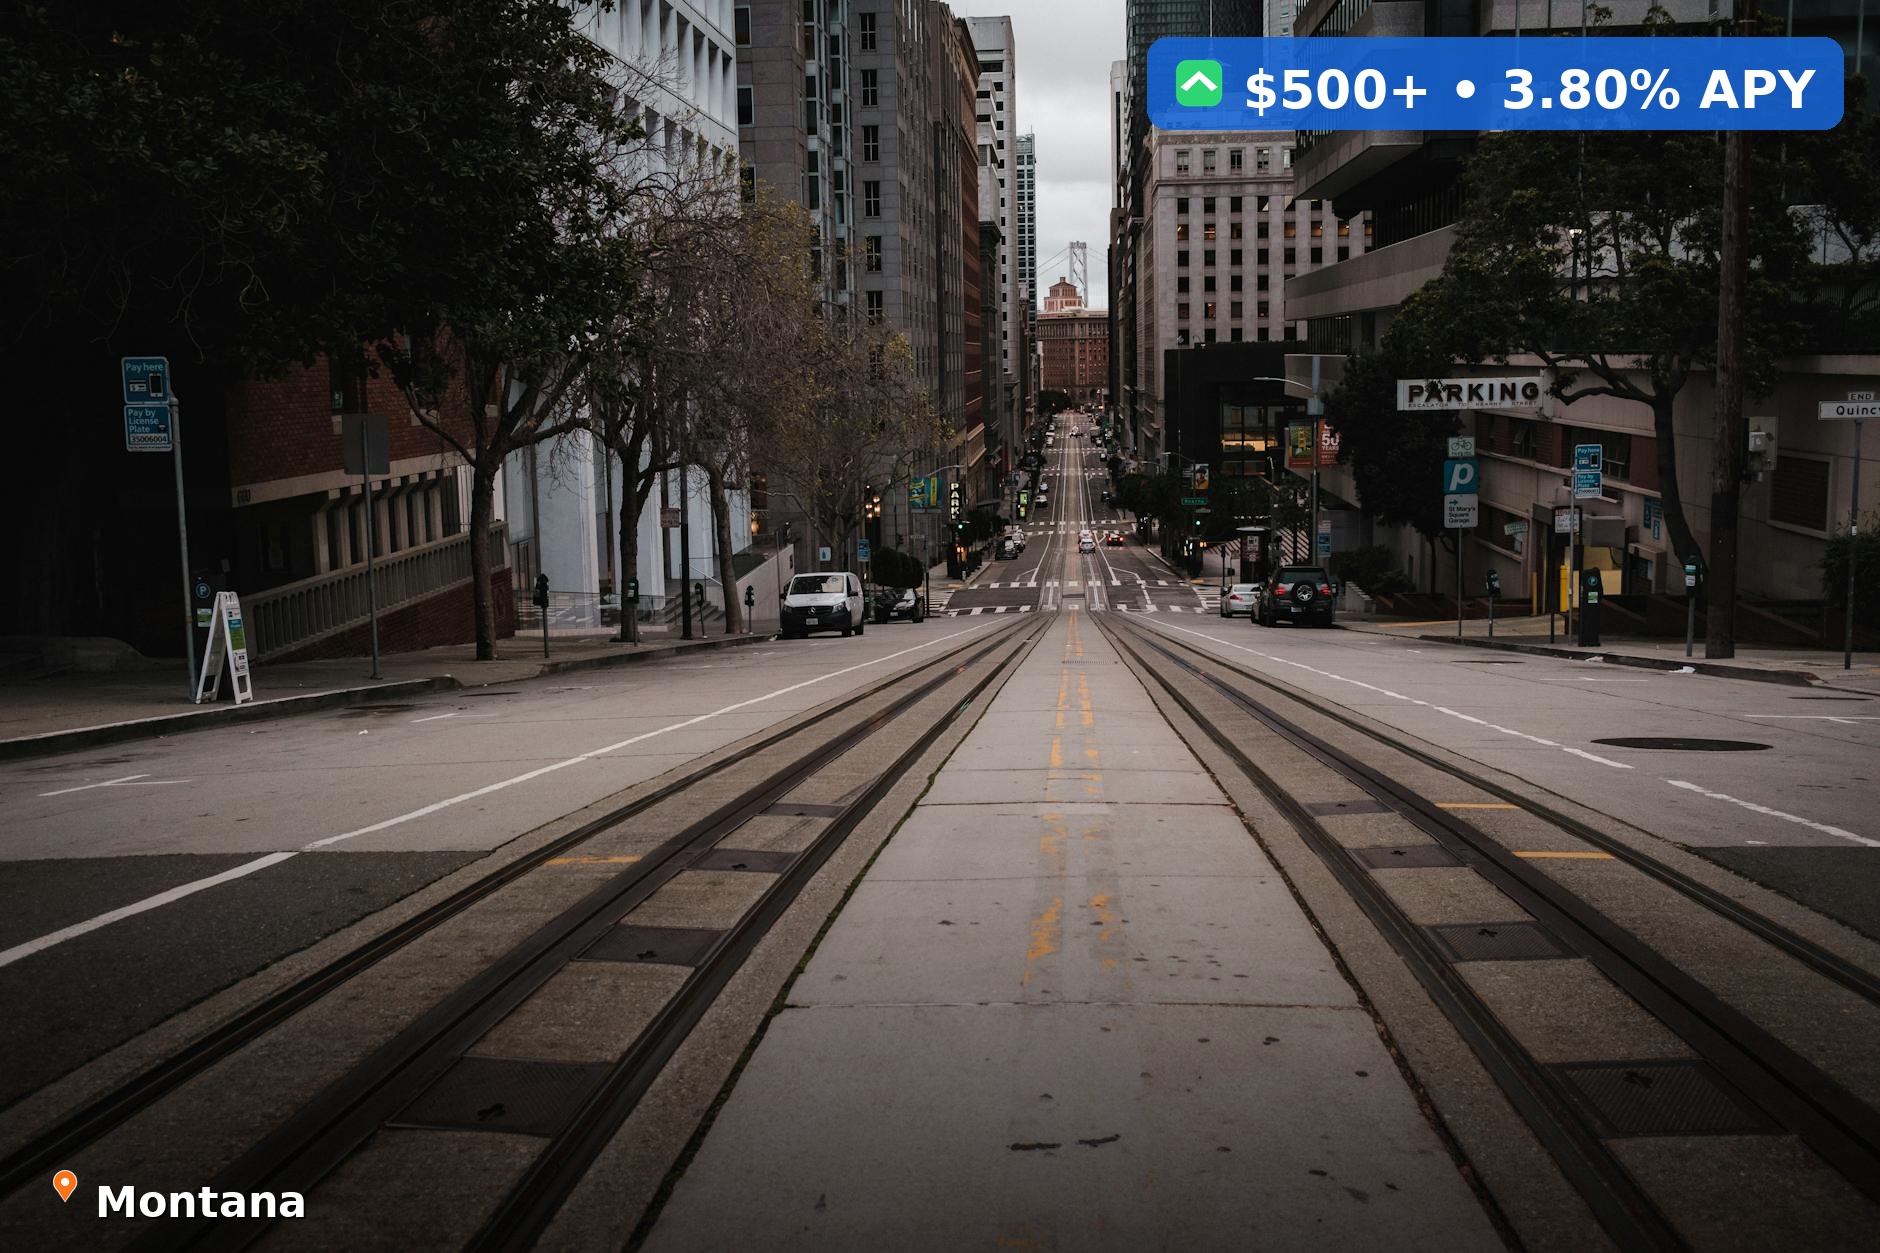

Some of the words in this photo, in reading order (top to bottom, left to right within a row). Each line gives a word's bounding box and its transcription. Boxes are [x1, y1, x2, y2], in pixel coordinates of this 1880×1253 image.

[125, 362, 142, 373] Pay
[143, 361, 164, 371] here
[1408, 382, 1539, 402] PARKING
[128, 408, 144, 419] Pay
[145, 409, 156, 418] by
[1836, 405, 1880, 416] Quinc
[129, 424, 151, 433] Plate
